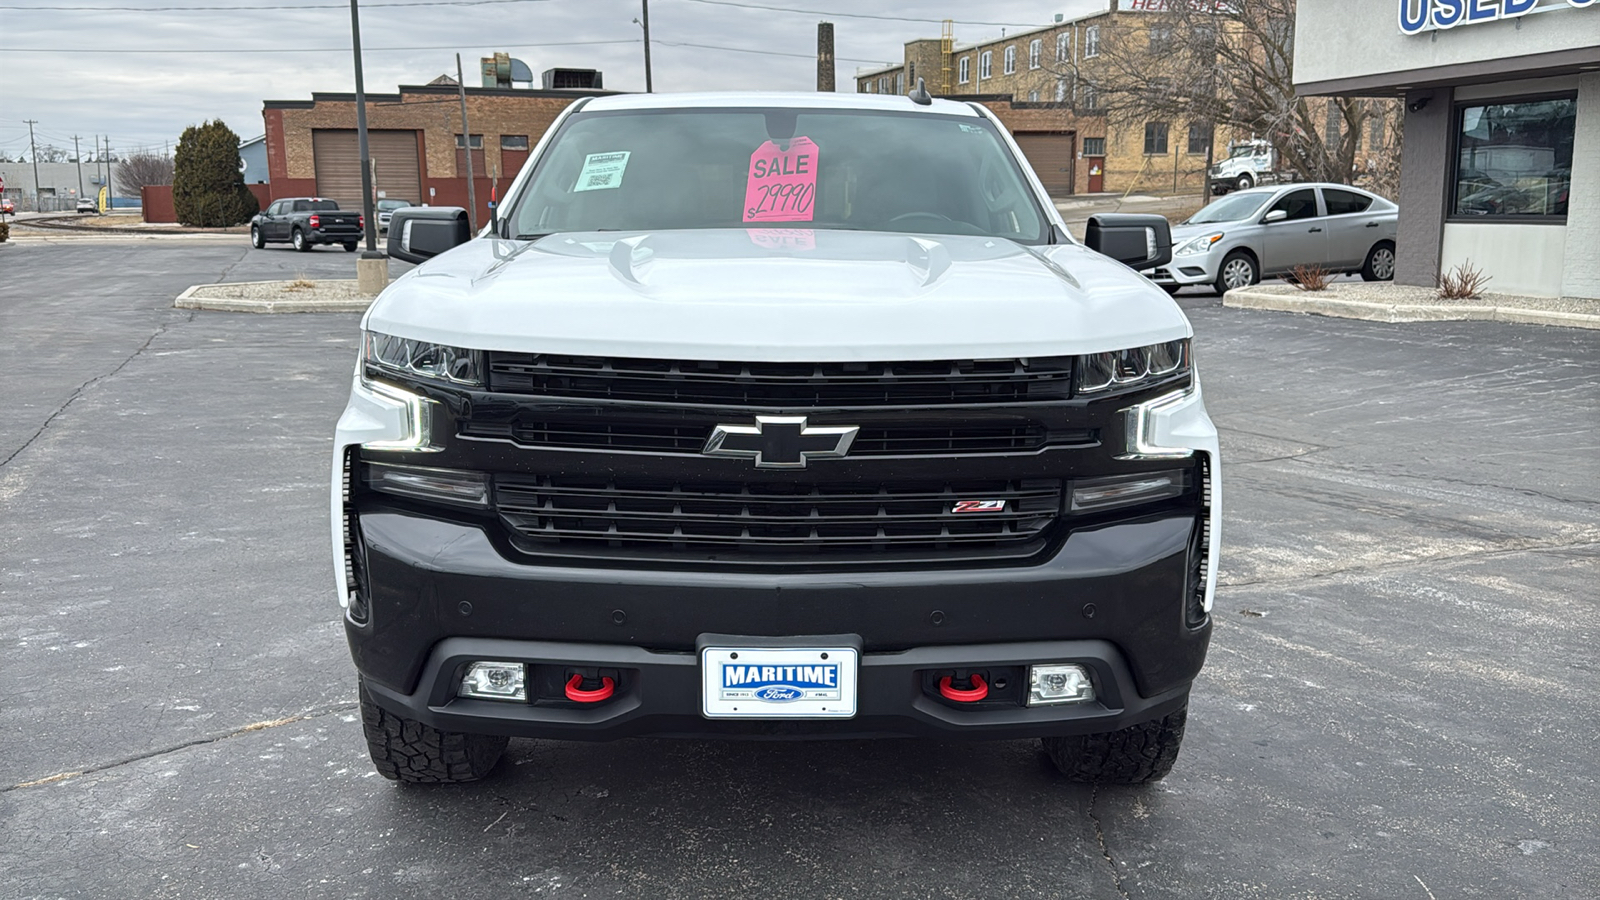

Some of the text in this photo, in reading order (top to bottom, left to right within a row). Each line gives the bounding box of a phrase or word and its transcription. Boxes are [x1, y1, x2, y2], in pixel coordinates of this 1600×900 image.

[753, 154, 810, 178] SALE
[747, 182, 815, 219] $29990
[952, 500, 1006, 513] Z71
[725, 666, 836, 687] MARITIME
[763, 688, 795, 700] Ford
